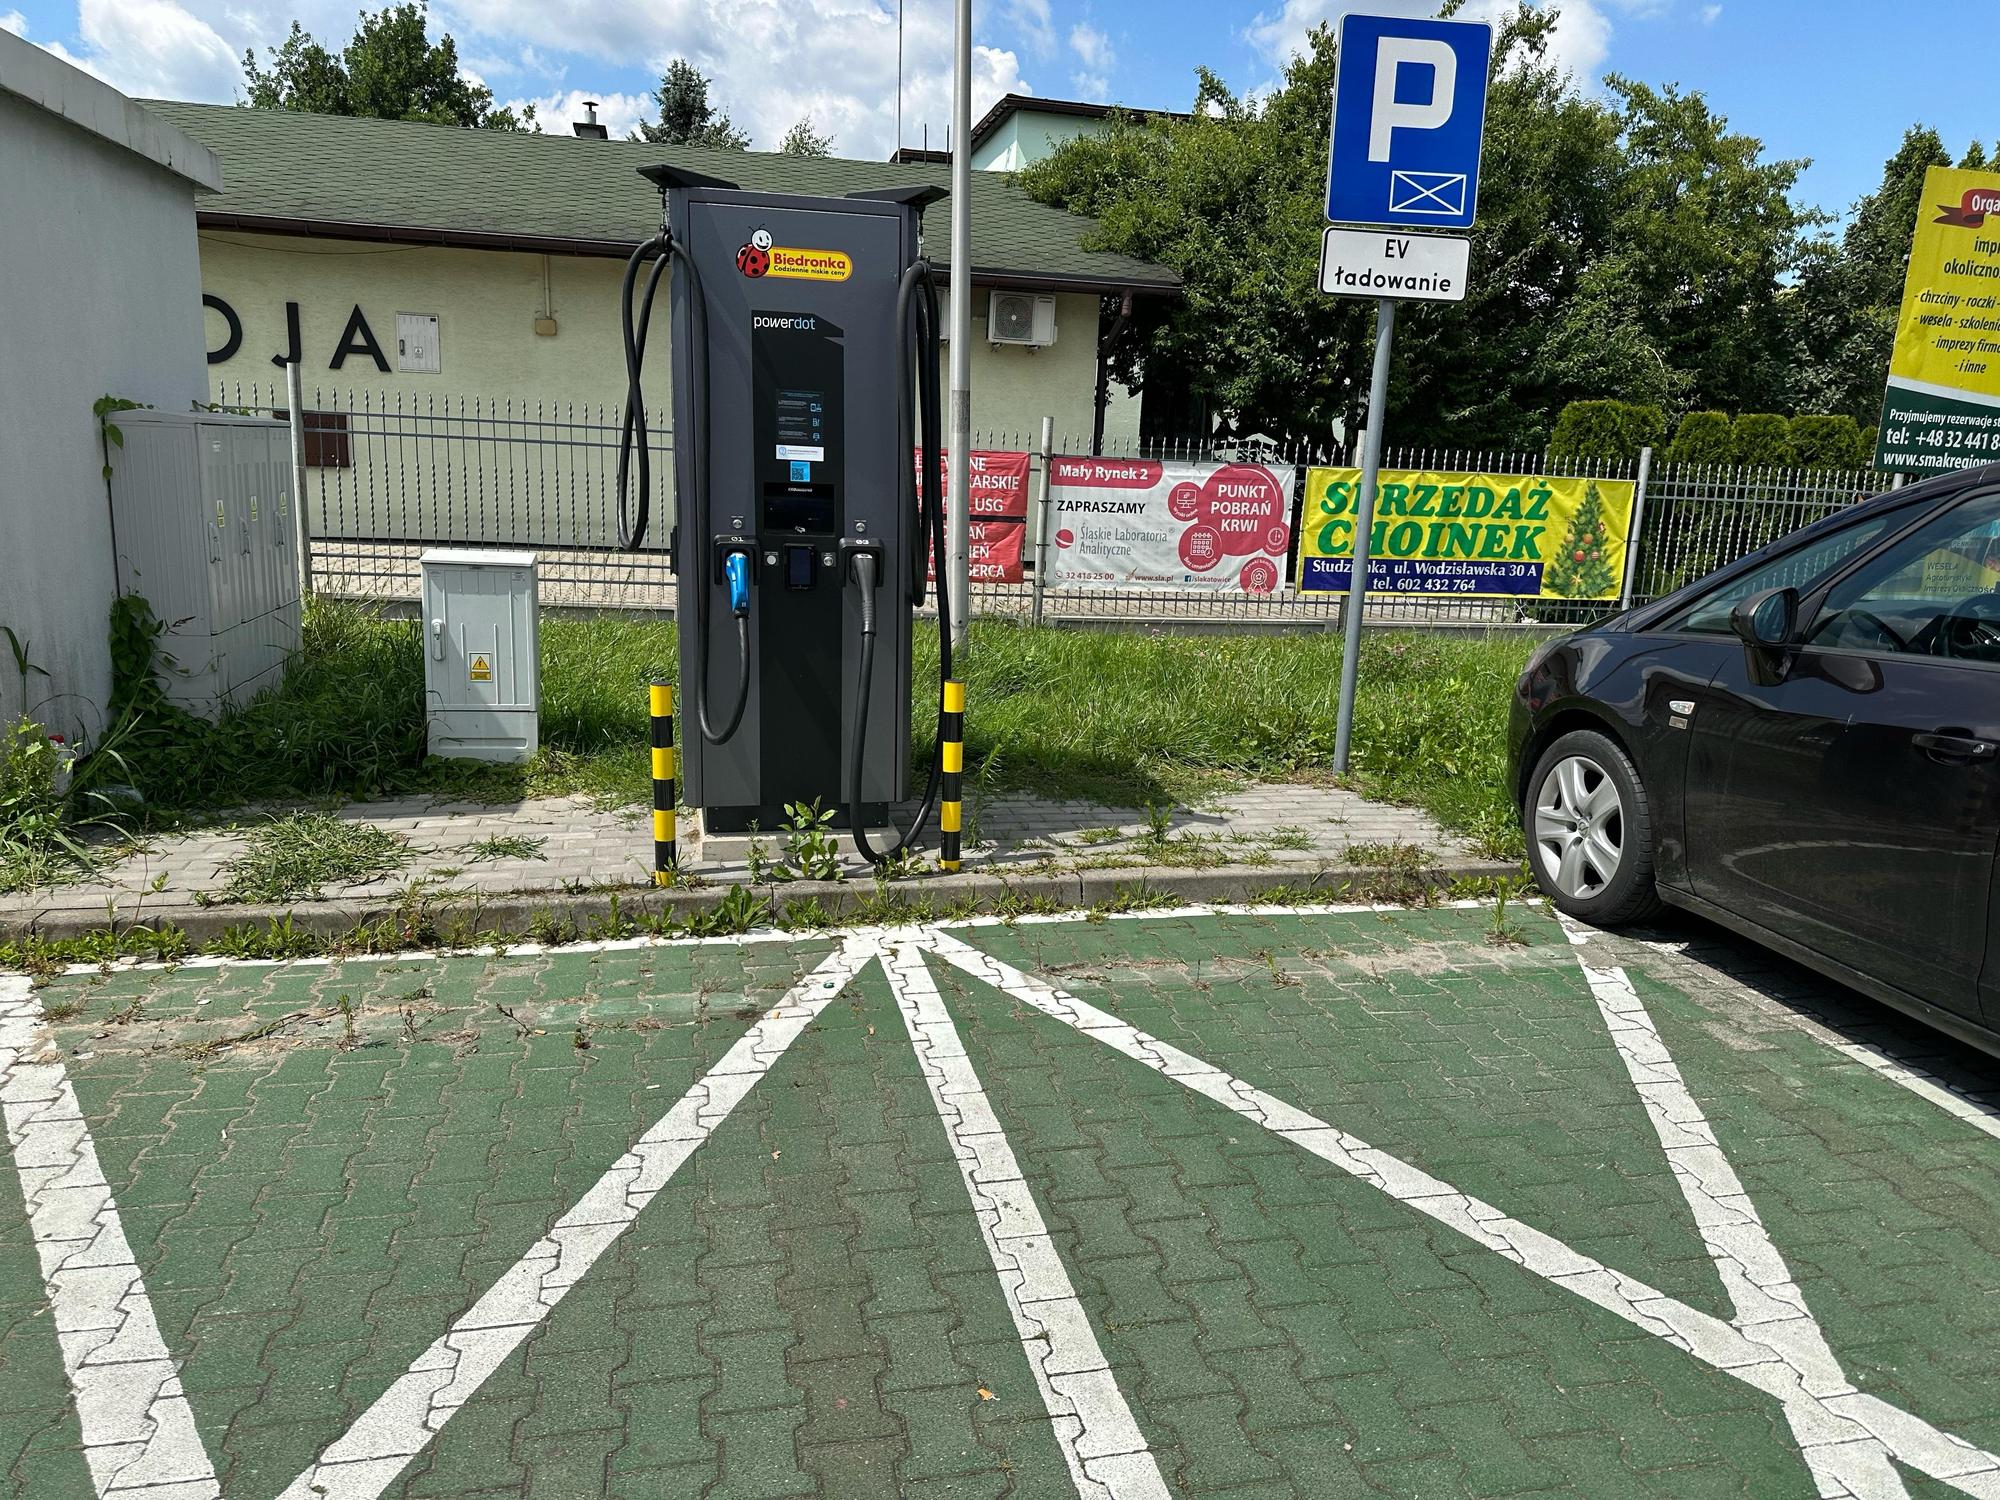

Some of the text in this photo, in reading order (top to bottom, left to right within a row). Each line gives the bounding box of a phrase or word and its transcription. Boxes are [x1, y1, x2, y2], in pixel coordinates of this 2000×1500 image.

[1368, 36, 1457, 163] P
[1385, 239, 1410, 259] EV
[773, 253, 846, 269] Biedronka
[773, 265, 809, 273] Codziennie
[1943, 258, 2000, 278] okoliczno
[1335, 266, 1451, 292] ładowanie
[1920, 290, 1960, 308] chrzciny
[1966, 296, 1997, 309] roczki
[753, 316, 816, 330] powerdot
[1919, 314, 1953, 327] wesela
[1935, 335, 1977, 354] imprezy
[1964, 360, 1987, 373] inne
[1889, 408, 1946, 426] Przyjmujemy
[1947, 414, 1992, 429] rezerwacje
[1886, 427, 2000, 451] tel: +48 32 441 8
[1059, 464, 1148, 481] Mały Rynek 2
[1218, 484, 1267, 498] PUNKT
[975, 498, 1004, 512] USG
[1057, 500, 1146, 514] ZAPRASZAMY
[1211, 500, 1271, 515] POBRAŃ
[1080, 523, 1168, 543] Śląskie Laboratoria
[1221, 519, 1258, 532] KRWI
[1317, 519, 1546, 560] CHOINEK
[1079, 542, 1131, 559] Analityczne
[1066, 571, 1075, 580] 32
[1104, 572, 1115, 580] 00
[1312, 560, 1537, 577] Studzika ul. Wodzisławska 30 A
[1135, 574, 1174, 582] www.sla.pl
[1373, 576, 1476, 591] tel. 602 432 764
